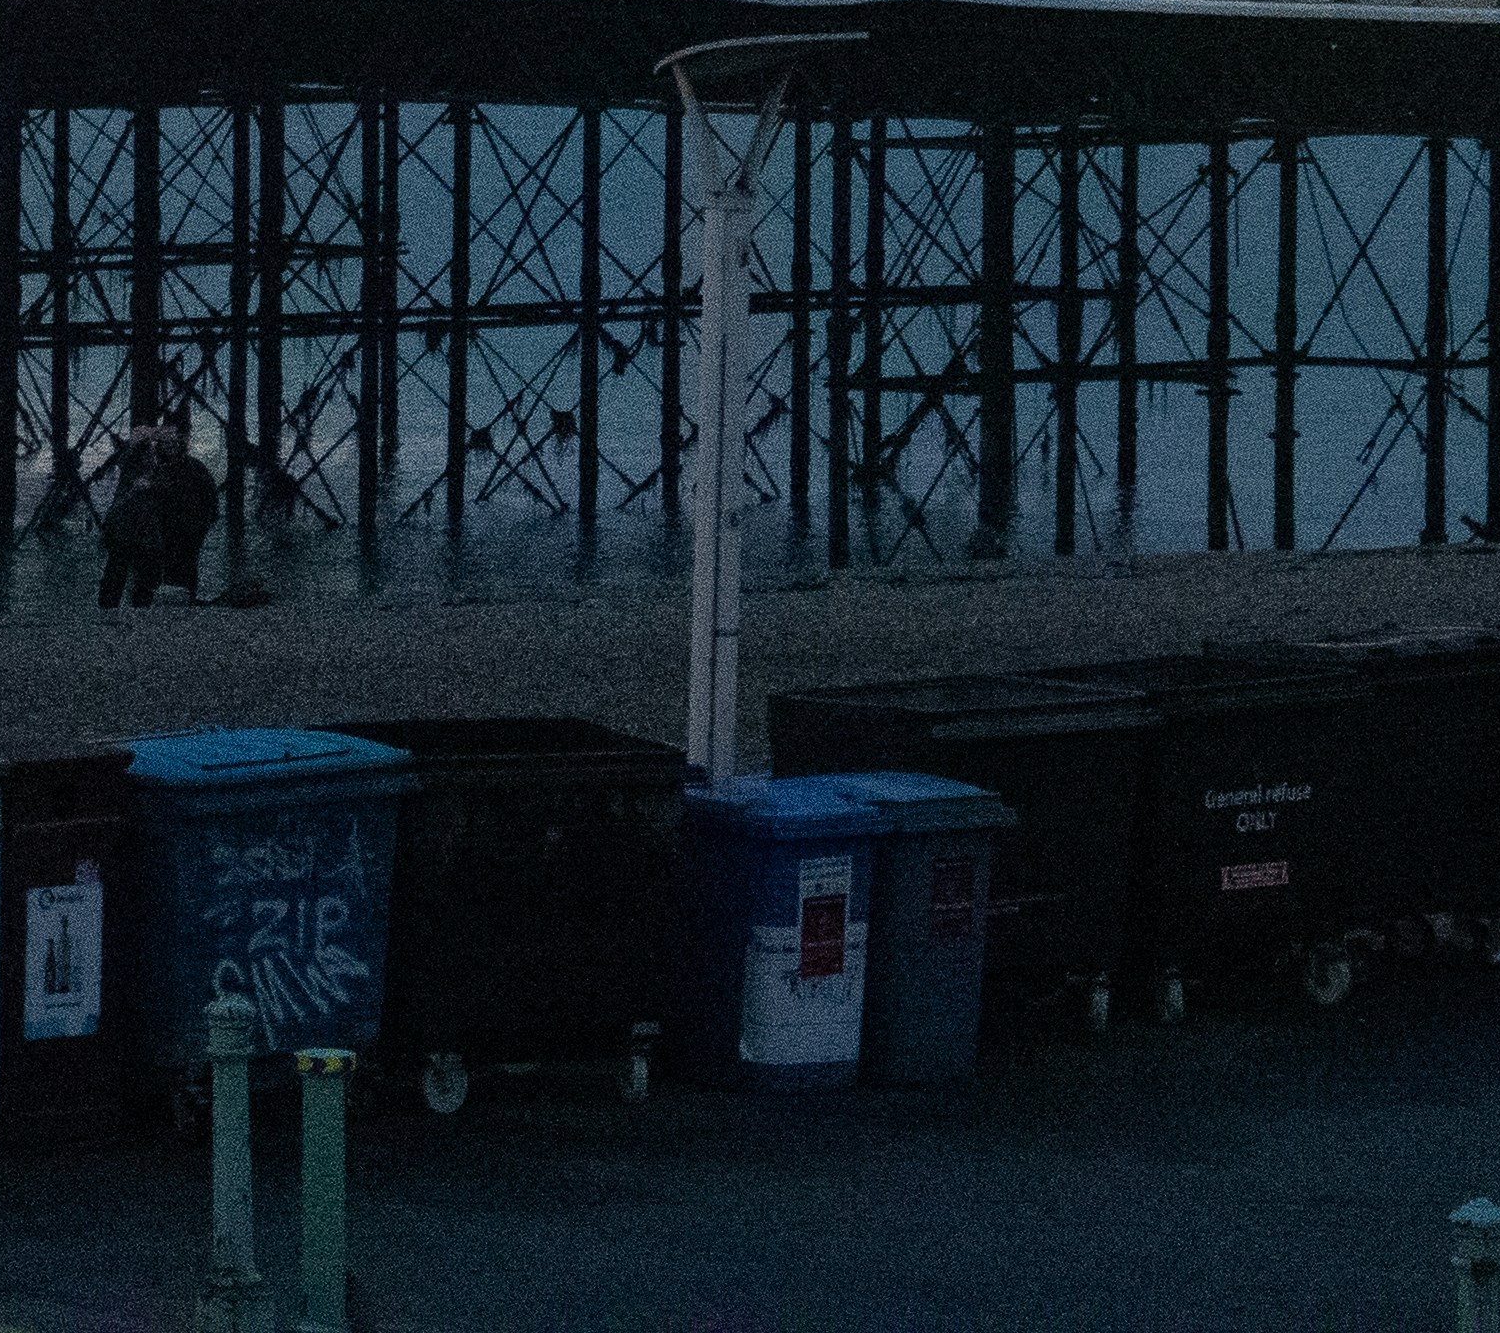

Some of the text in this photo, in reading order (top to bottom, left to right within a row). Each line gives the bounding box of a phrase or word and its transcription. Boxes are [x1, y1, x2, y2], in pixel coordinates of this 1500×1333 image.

[1203, 781, 1313, 810] General refuse
[1235, 811, 1278, 834] ONLY
[247, 895, 350, 961] ZIP
